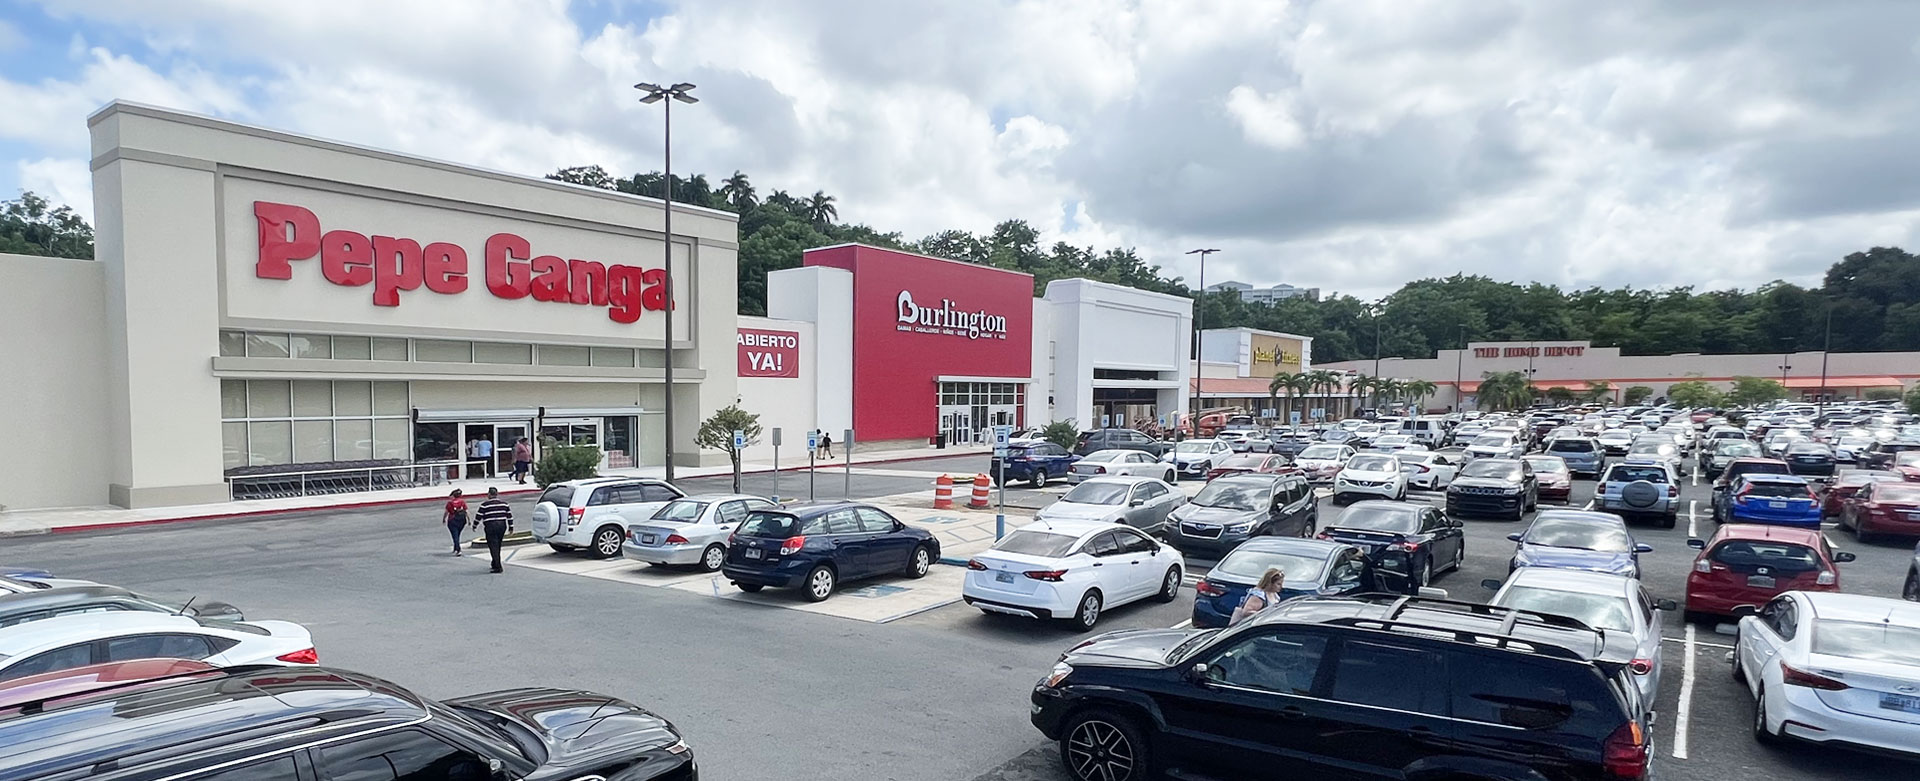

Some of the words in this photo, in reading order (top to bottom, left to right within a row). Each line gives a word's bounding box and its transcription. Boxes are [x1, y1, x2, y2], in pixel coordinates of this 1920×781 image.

[253, 200, 469, 306] Pepe
[485, 232, 675, 324] Ganga
[897, 289, 1007, 340] Burlington
[737, 333, 796, 349] ABIERTO
[747, 351, 782, 371] YA!
[1474, 348, 1499, 358] THE
[1503, 347, 1540, 358] HOME
[1544, 346, 1585, 357] DEPOT
